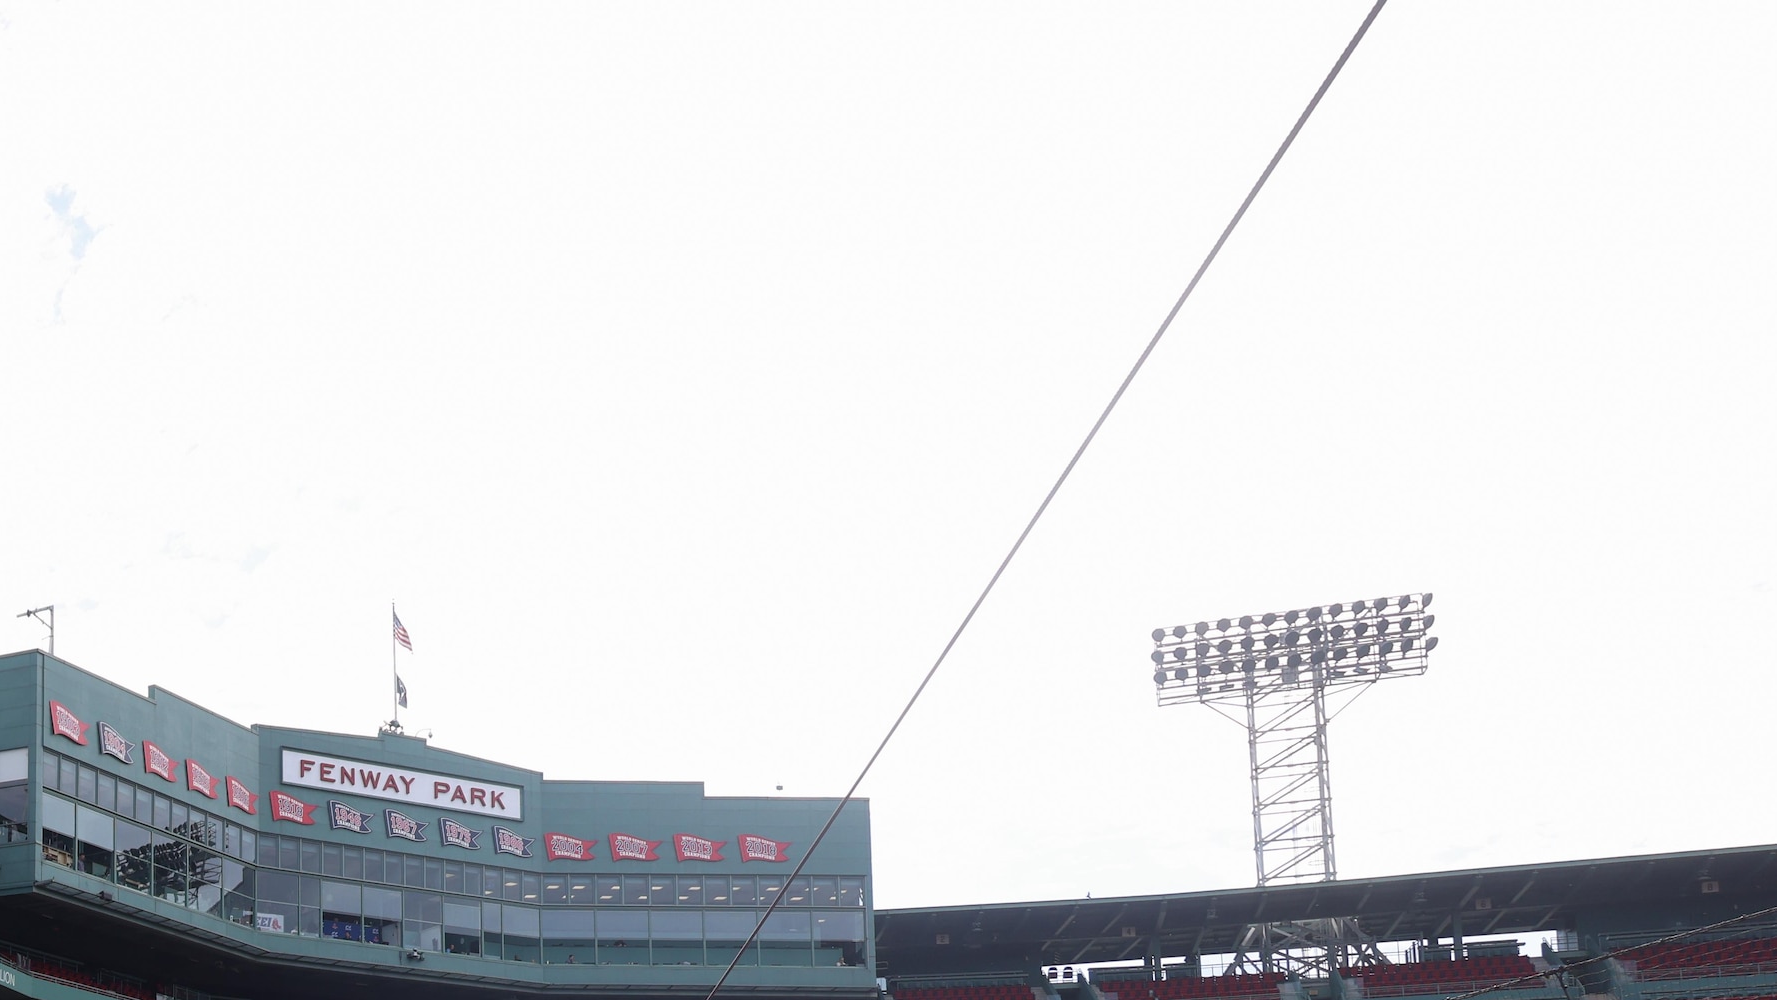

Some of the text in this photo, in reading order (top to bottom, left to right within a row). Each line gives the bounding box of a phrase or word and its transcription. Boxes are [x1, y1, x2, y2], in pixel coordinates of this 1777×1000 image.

[300, 759, 505, 810] FENWAY PARK
[278, 798, 303, 817] 1918
[335, 808, 361, 827] 1946
[391, 816, 417, 835] 1967
[446, 825, 471, 844] 1975
[551, 840, 583, 856] 2004
[615, 840, 647, 856] 2007
[681, 840, 713, 856] 2013
[746, 840, 778, 856] 2018
